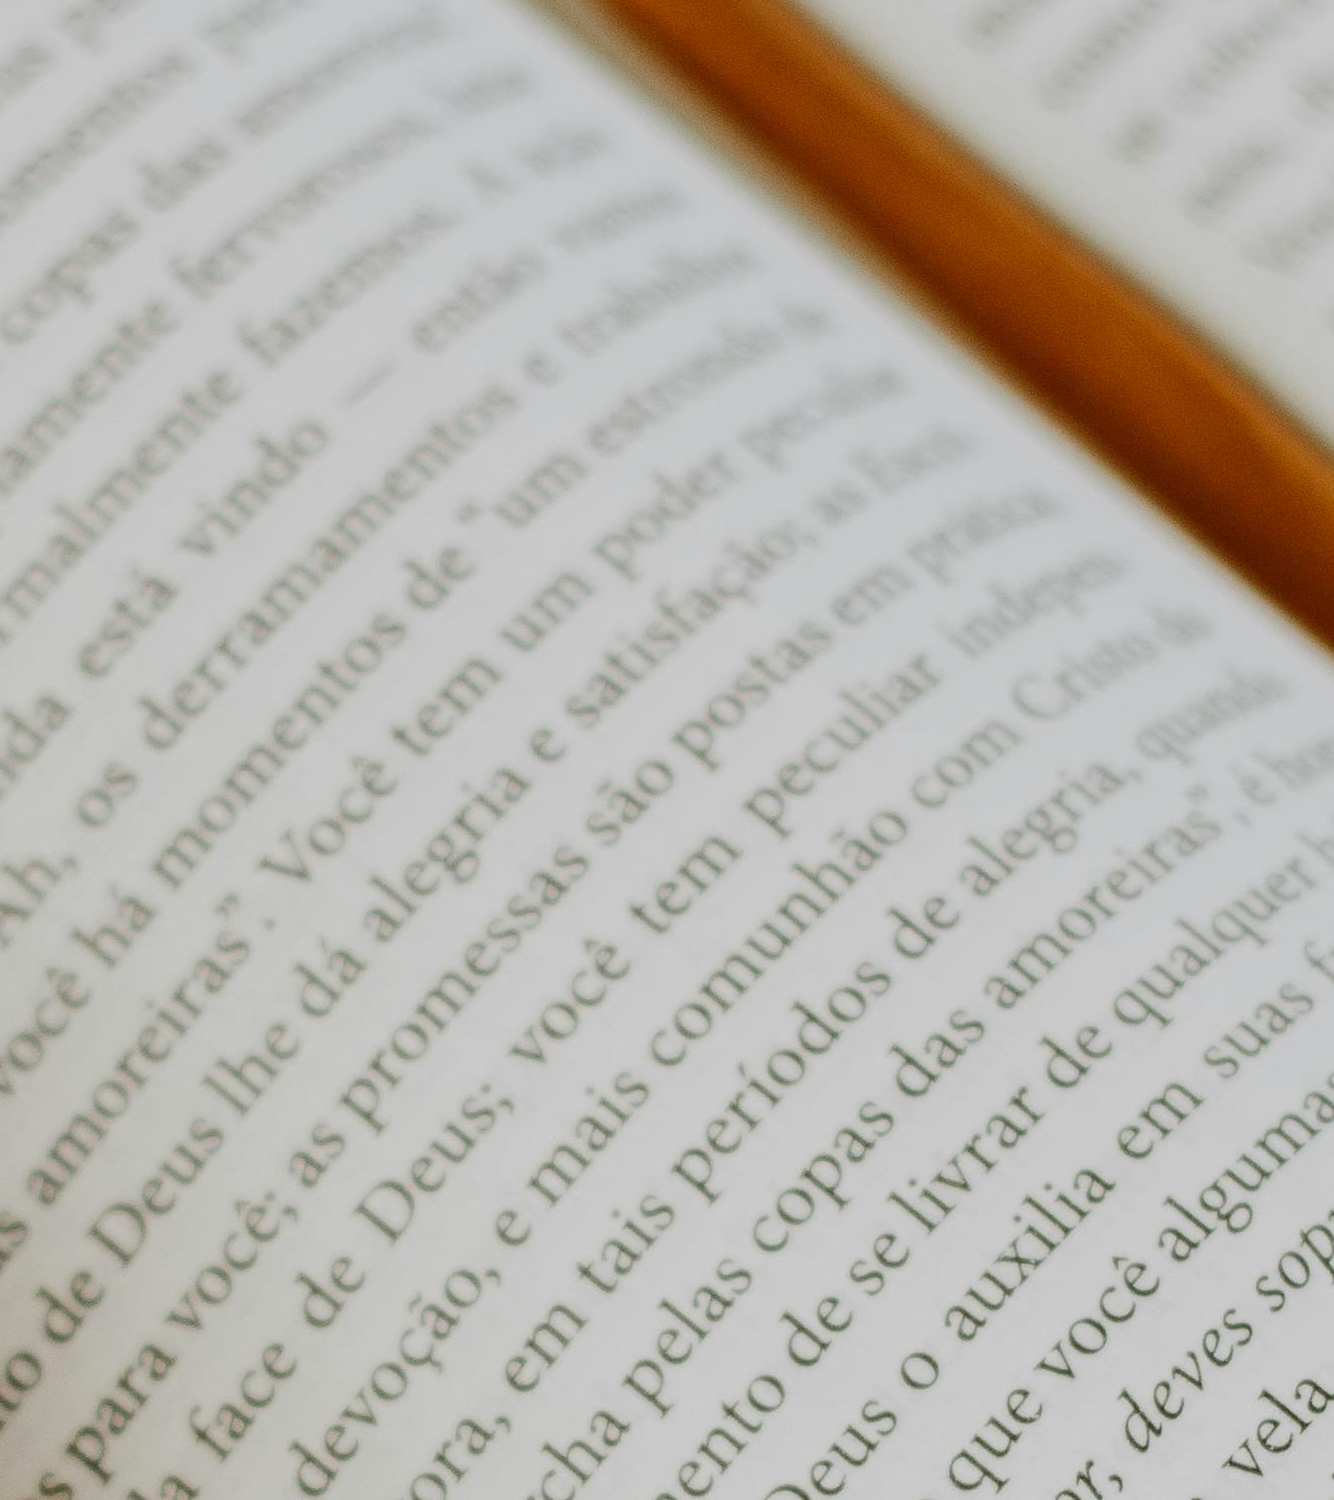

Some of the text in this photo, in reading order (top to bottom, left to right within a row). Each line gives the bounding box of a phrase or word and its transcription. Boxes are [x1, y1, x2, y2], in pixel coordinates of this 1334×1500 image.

[254, 754, 399, 884] Você
[387, 655, 505, 759] tem
[496, 568, 598, 655] um
[588, 449, 740, 585] poder
[63, 1342, 178, 1487] para
[162, 1190, 300, 1332] você;
[286, 1121, 347, 1190] as
[336, 844, 591, 1137] promessas
[584, 758, 676, 848] são
[668, 619, 834, 775] postas
[287, 1267, 502, 1499] devoção,
[493, 1207, 532, 1248] e
[525, 1070, 651, 1208] mais
[648, 809, 909, 1069] comunhão
[908, 718, 1026, 811] com
[620, 1258, 753, 1419] pelas
[751, 1100, 896, 1254] copas
[887, 1008, 986, 1099] das
[779, 1295, 853, 1368] de
[847, 1231, 911, 1297] se
[886, 1085, 1045, 1235] livrar
[1038, 1024, 1113, 1090] de
[1110, 856, 1318, 1030] qualquer
[898, 1350, 940, 1391] o
[943, 1167, 1117, 1343] auxilia
[1115, 1081, 1205, 1161] em
[1201, 982, 1315, 1080] suas
[947, 1387, 1044, 1494] que
[1033, 1254, 1161, 1380] você
[1117, 1307, 1254, 1454] deves
